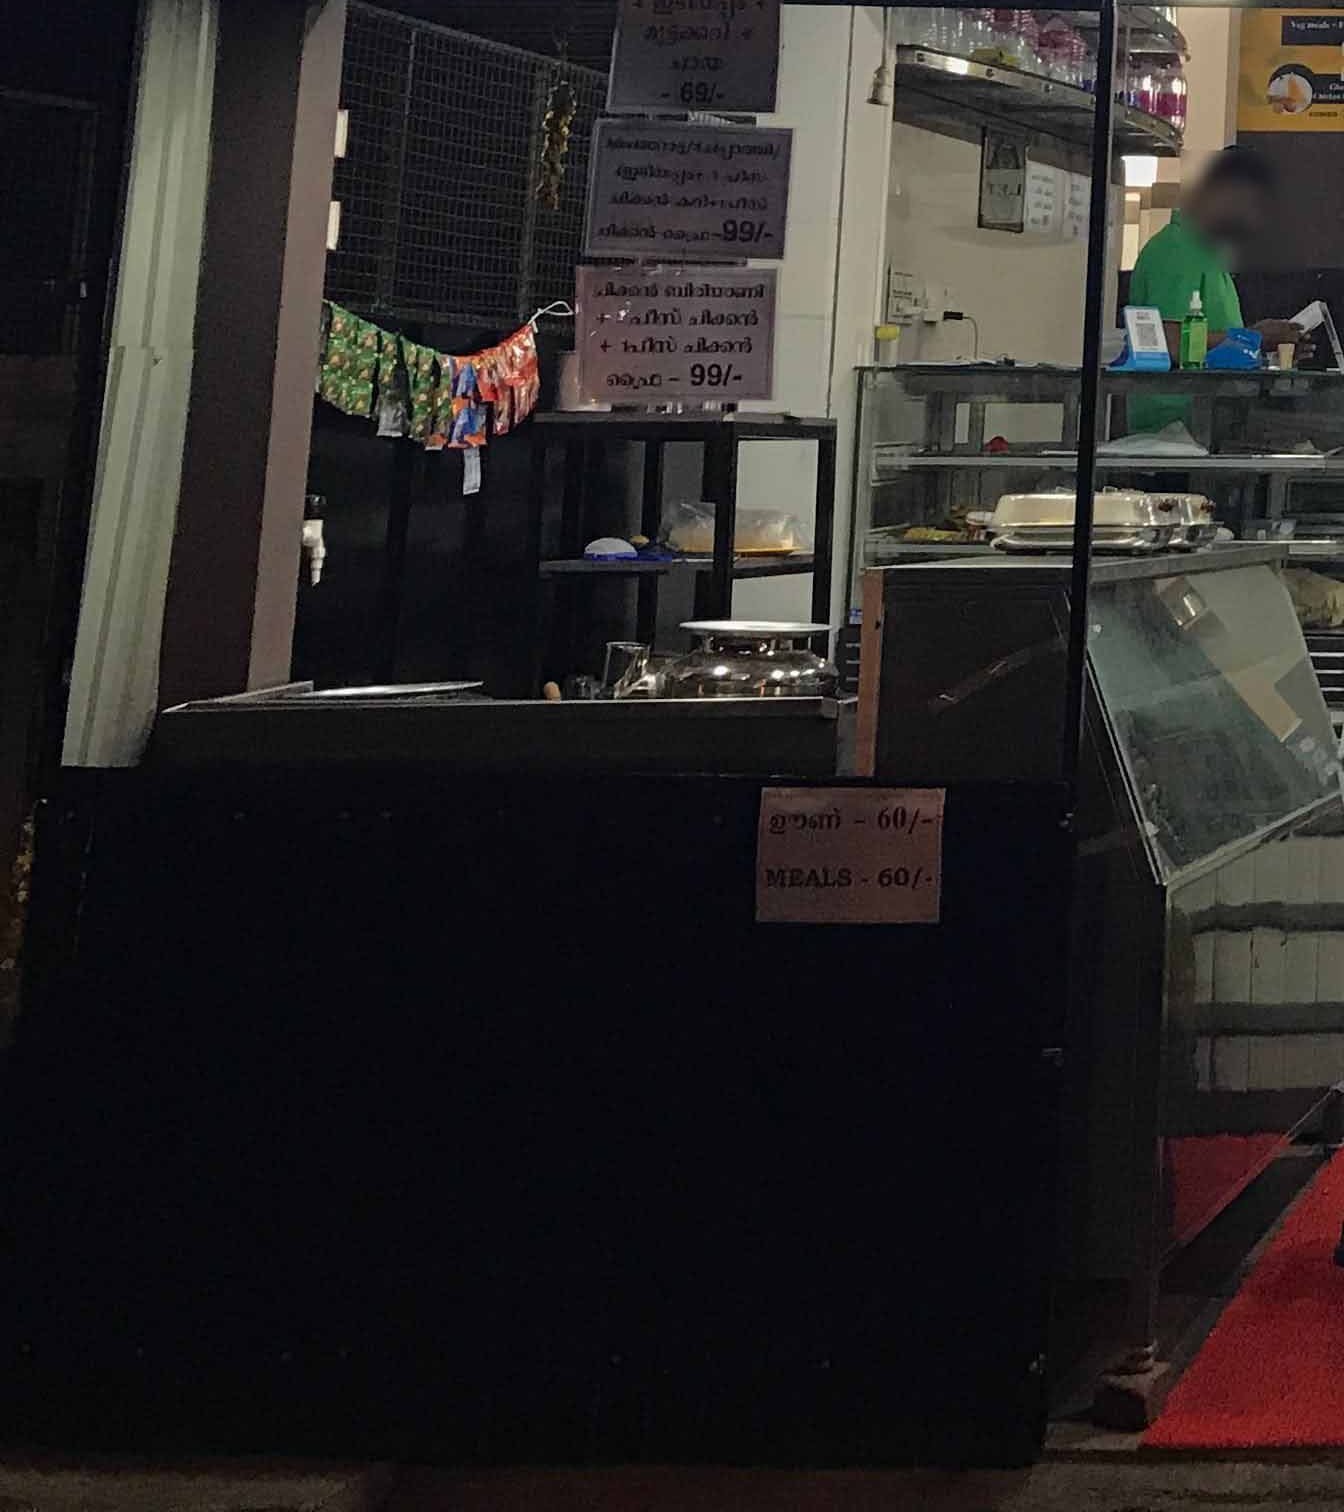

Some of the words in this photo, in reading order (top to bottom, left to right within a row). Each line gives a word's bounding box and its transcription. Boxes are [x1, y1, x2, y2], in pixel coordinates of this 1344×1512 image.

[690, 362, 743, 387] 99/-
[878, 806, 935, 835] 60/-
[765, 867, 852, 888] MEALS
[878, 867, 934, 888] 60/-
